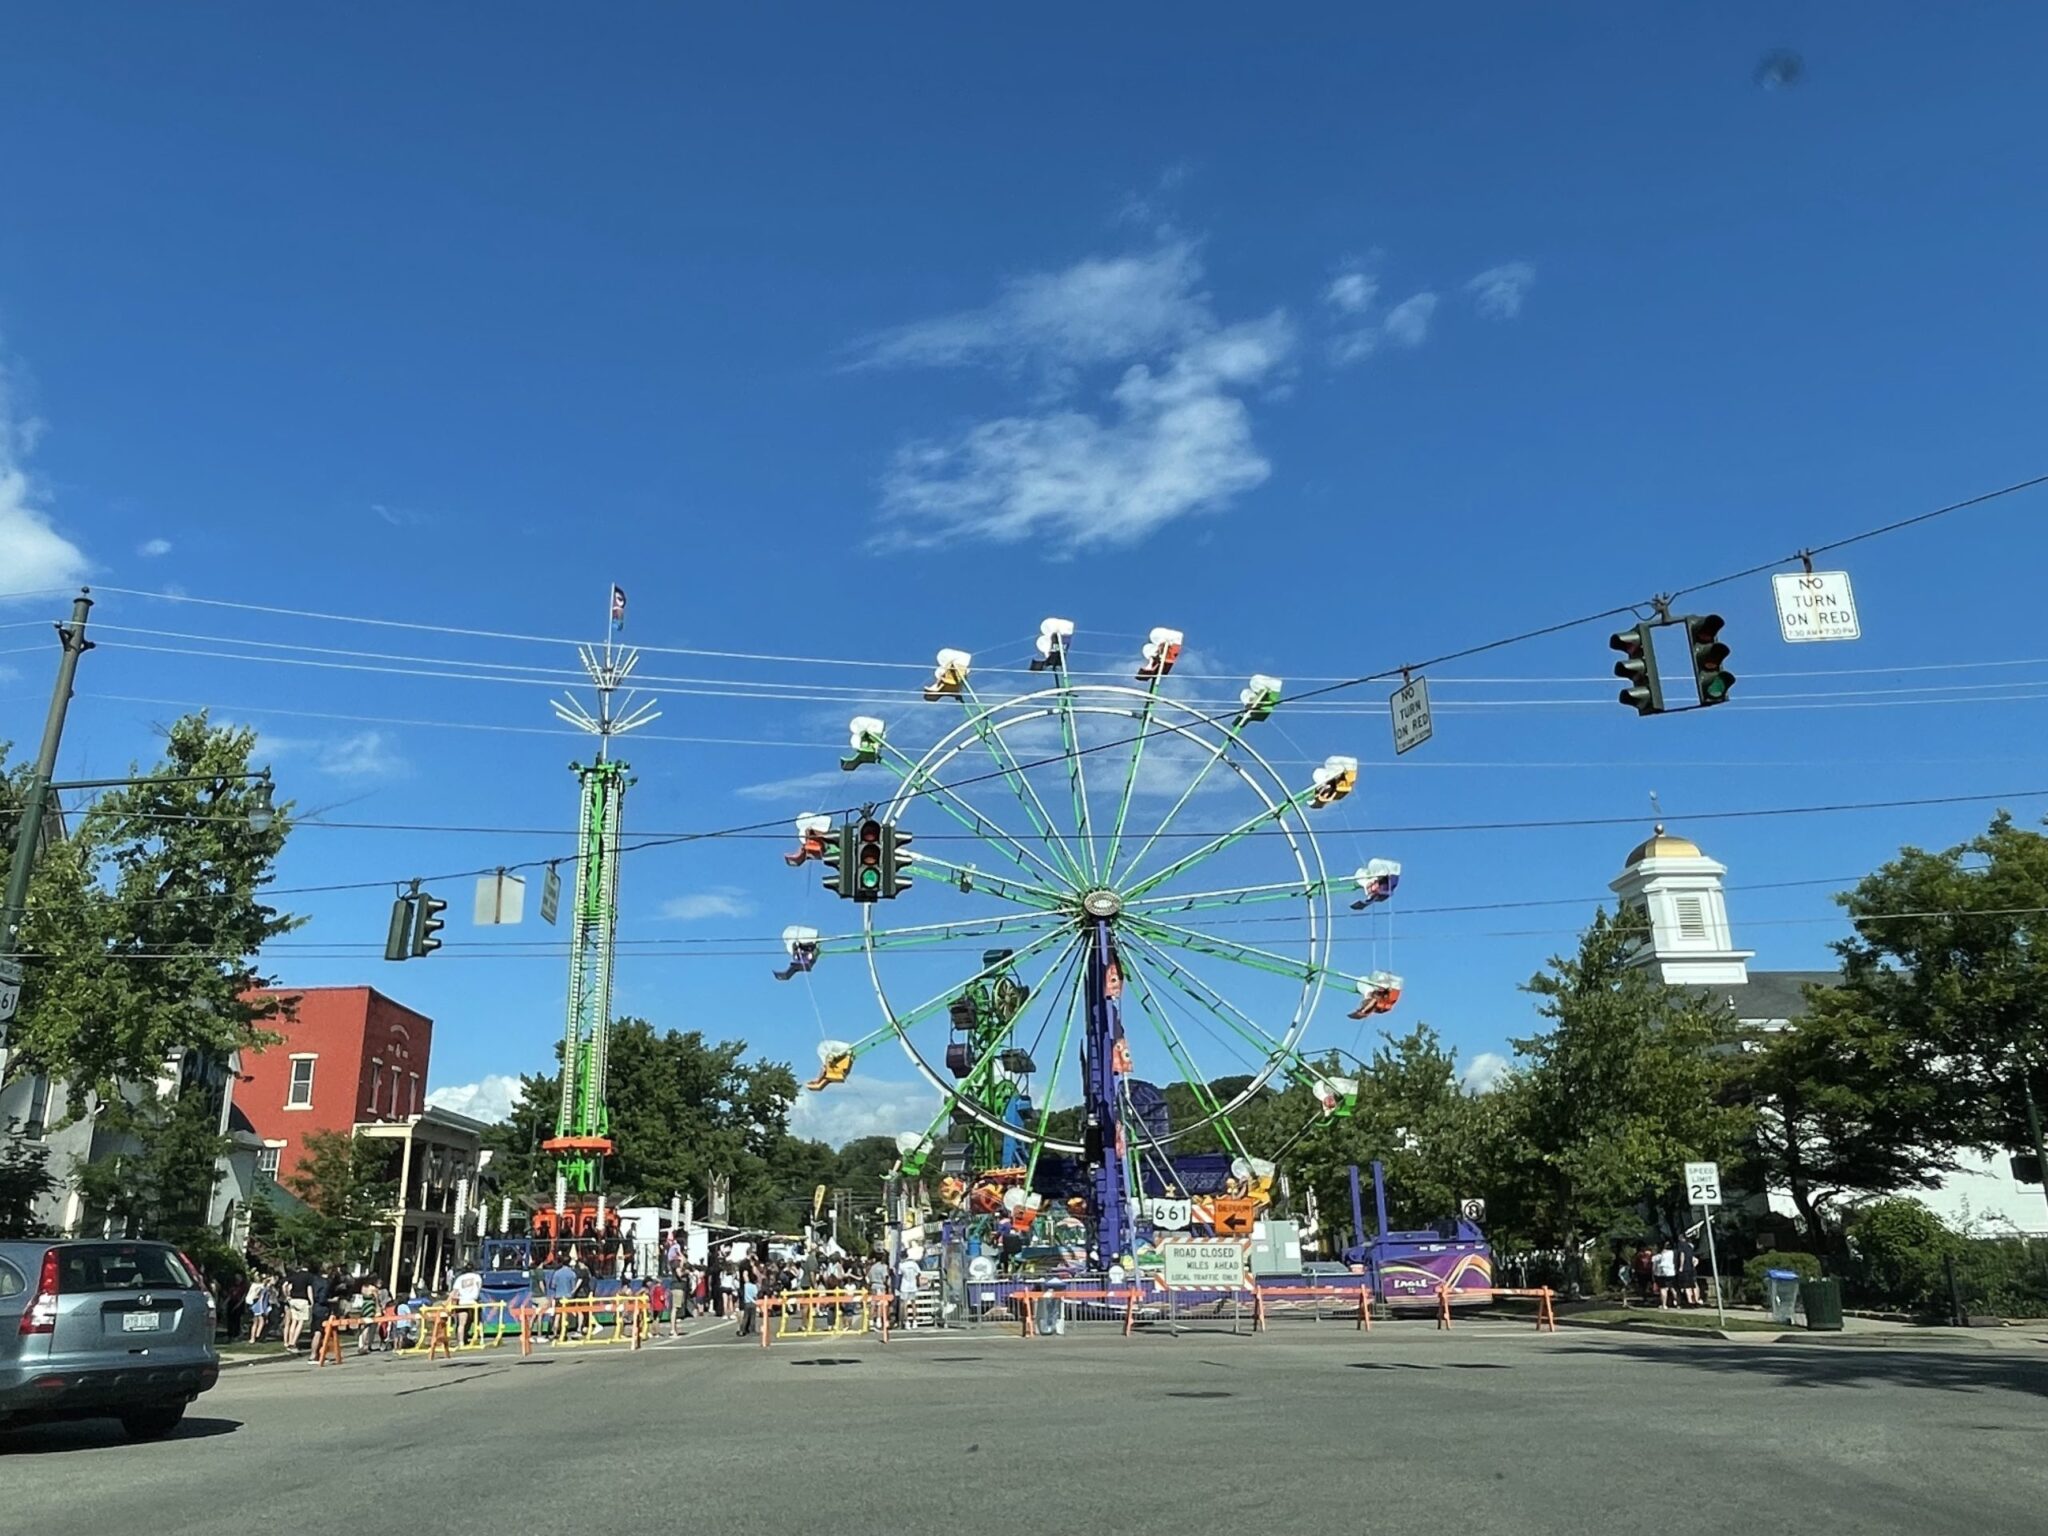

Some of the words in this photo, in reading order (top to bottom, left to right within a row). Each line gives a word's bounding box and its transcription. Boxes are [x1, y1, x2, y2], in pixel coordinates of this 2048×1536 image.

[1799, 578, 1823, 590] NO
[1793, 594, 1836, 608] TURN
[1786, 613, 1808, 626] ON
[1819, 611, 1850, 624] RED
[1401, 686, 1415, 702] NO
[1399, 700, 1421, 720] TURN
[1396, 724, 1409, 739] ON
[1412, 713, 1428, 731] RED
[0, 992, 15, 1011] 61
[1688, 1167, 1715, 1175] SPEED
[1691, 1184, 1717, 1199] 25
[1155, 1205, 1186, 1221] 661
[1173, 1247, 1197, 1258] ROAD
[1200, 1247, 1234, 1258] CLOSED
[1187, 1261, 1209, 1270] MILES
[1214, 1261, 1239, 1270] AHEAD
[1170, 1273, 1191, 1281] LOCAL
[1194, 1273, 1219, 1281] TRAFFIC
[1394, 1279, 1428, 1288] EAGLE
